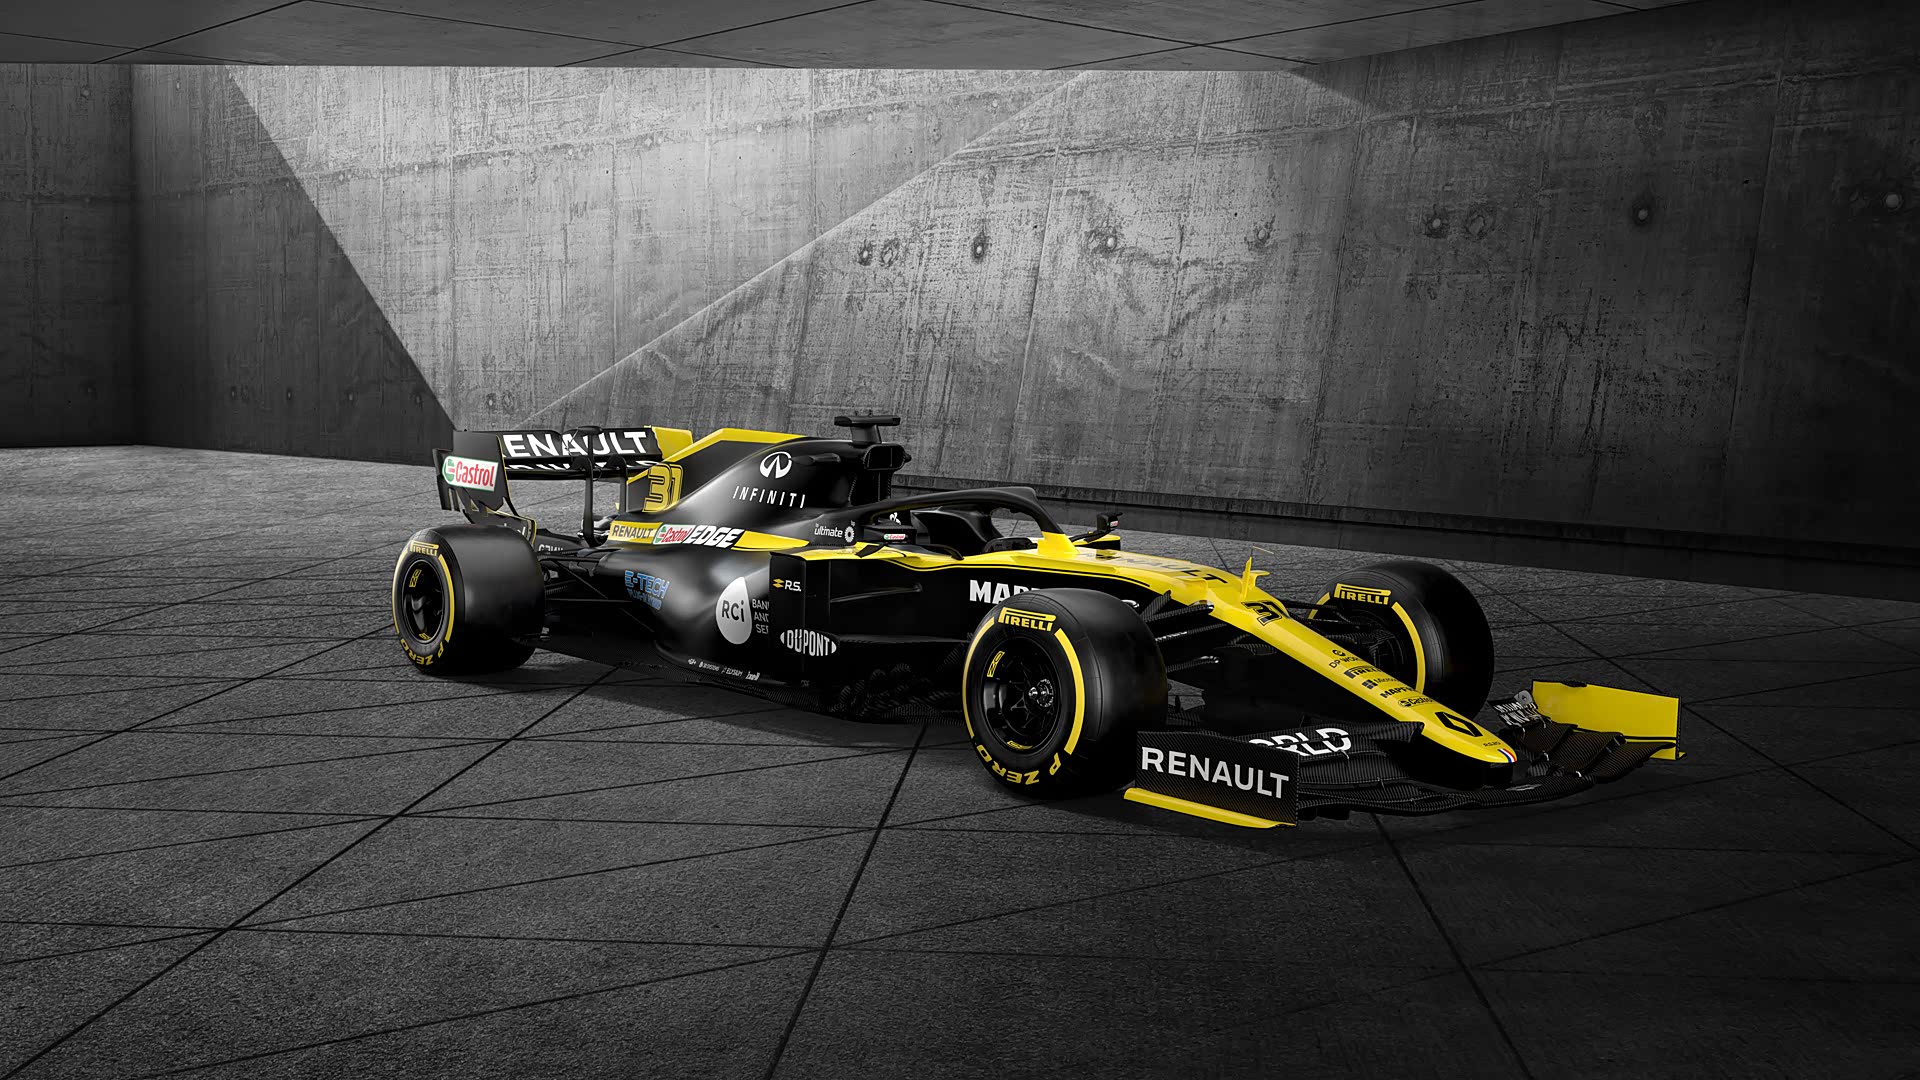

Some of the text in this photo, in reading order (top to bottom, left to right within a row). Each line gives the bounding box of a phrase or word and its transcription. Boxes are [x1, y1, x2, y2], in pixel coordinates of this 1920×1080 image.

[502, 431, 647, 457] ENAULT
[455, 462, 496, 487] Castrol
[642, 463, 683, 513] 31
[732, 485, 806, 509] INFINITI
[612, 524, 745, 549] RENAULT Castrol EDGE
[814, 525, 843, 538] ultimate
[409, 540, 439, 557] PIRELLI
[625, 570, 670, 599] E-TECH
[1333, 583, 1392, 605] PIRELLI
[752, 598, 770, 610] BAN
[998, 606, 1057, 632] PIRELLI
[400, 638, 434, 665] ZERO
[786, 629, 830, 656] DUPONT
[976, 744, 1062, 785] P ZERO
[1141, 746, 1290, 799] RENAULT
